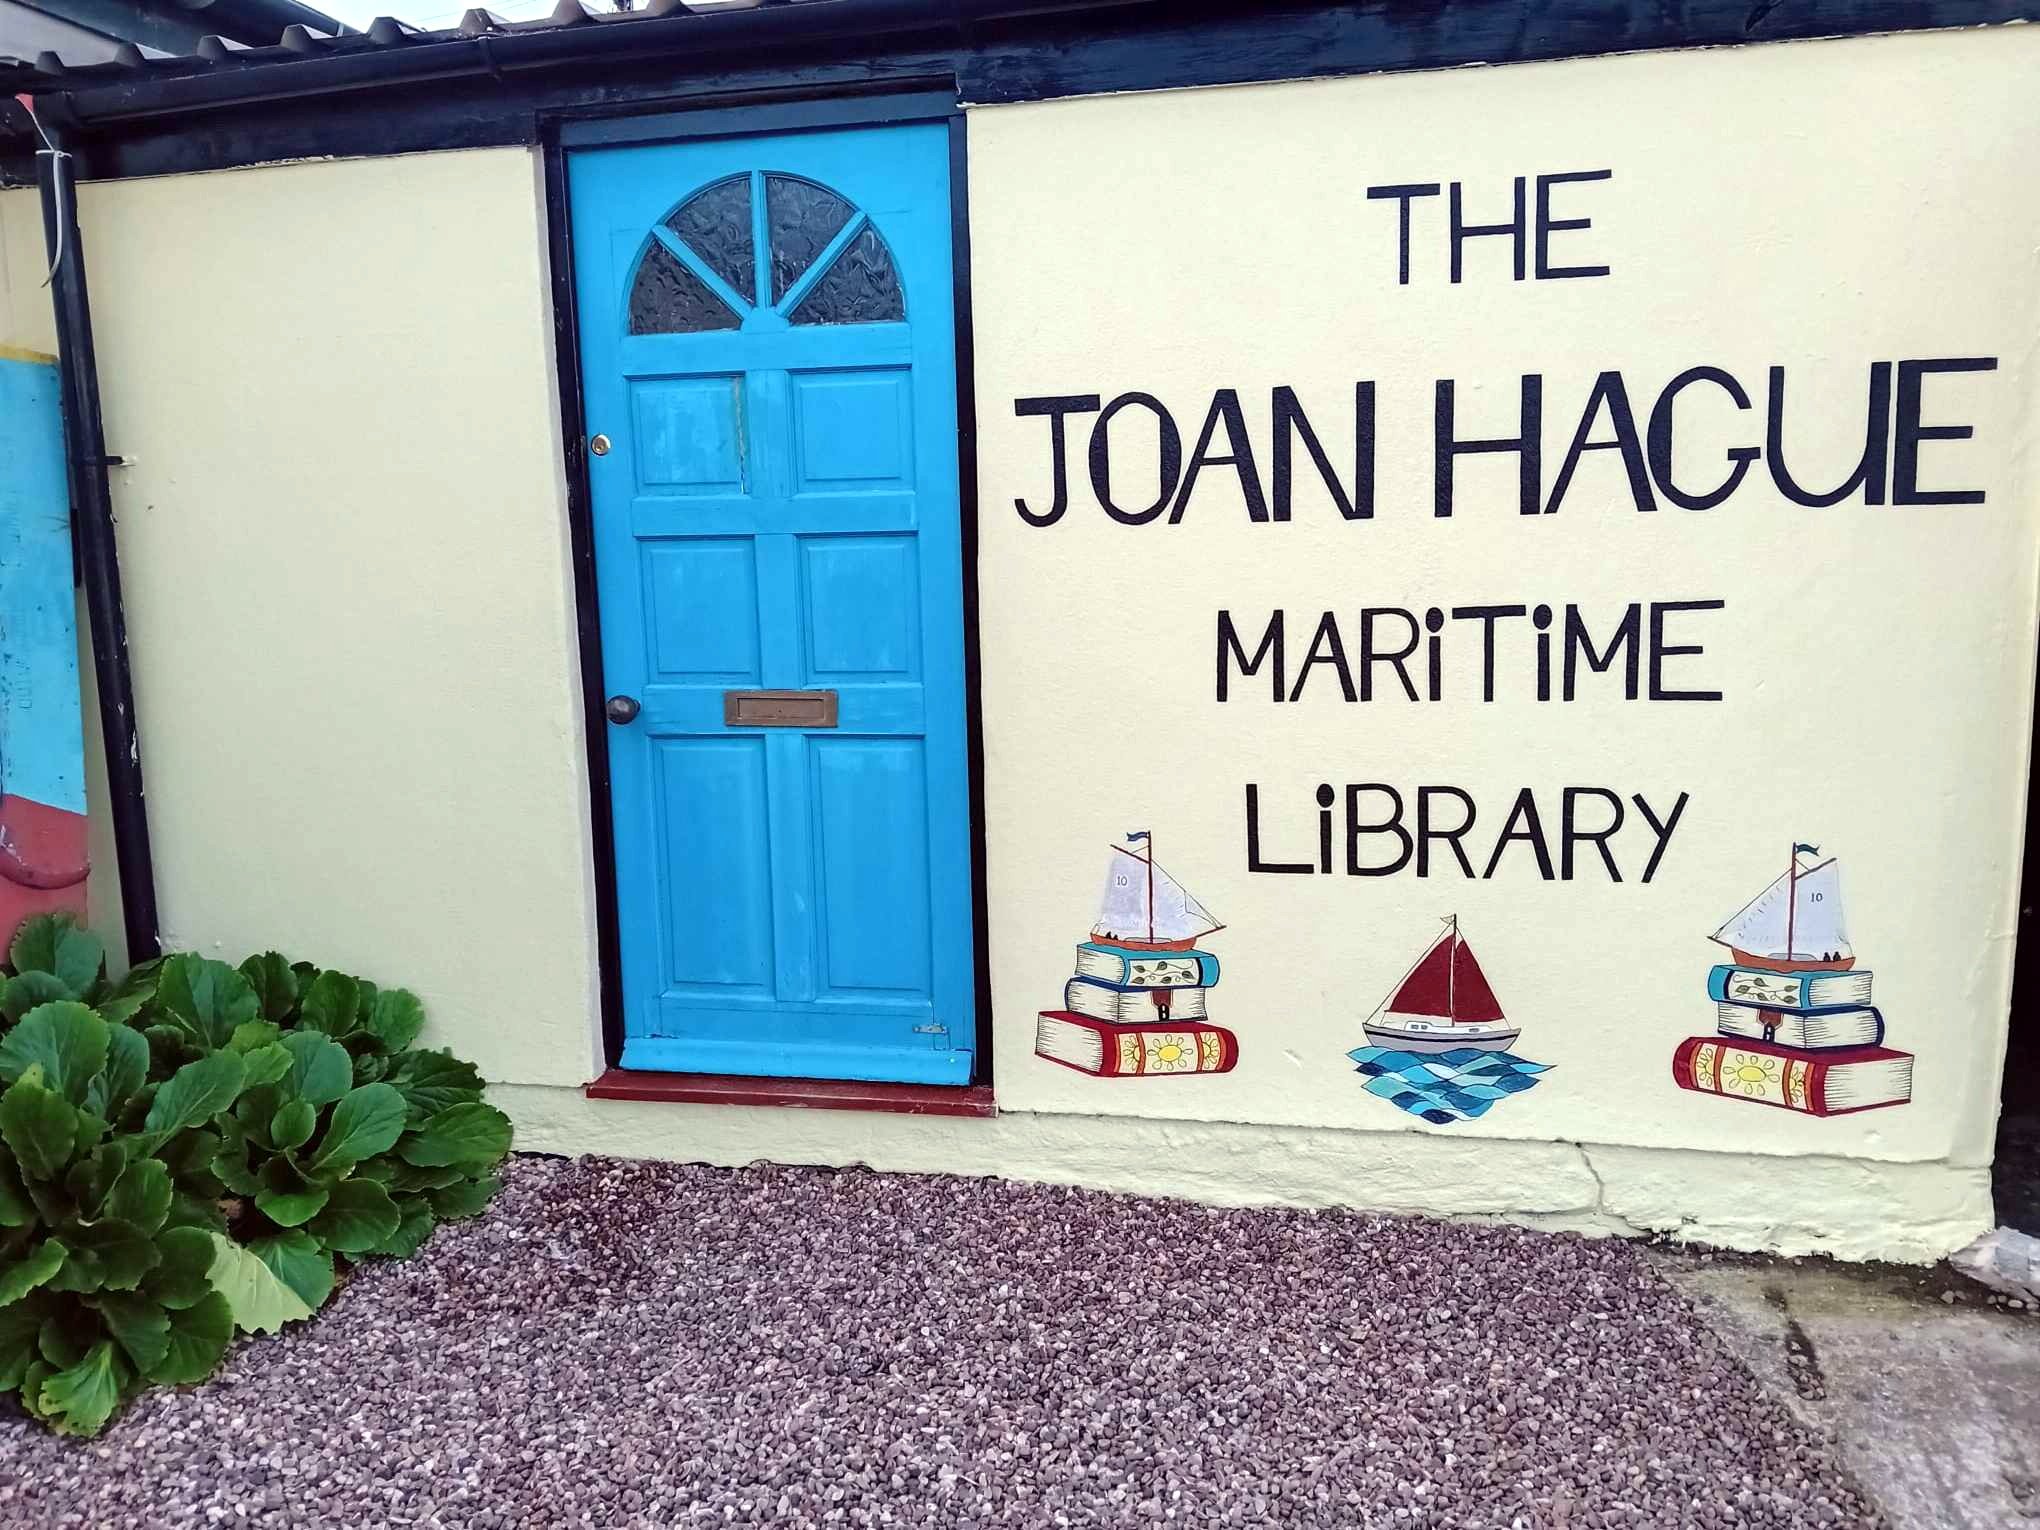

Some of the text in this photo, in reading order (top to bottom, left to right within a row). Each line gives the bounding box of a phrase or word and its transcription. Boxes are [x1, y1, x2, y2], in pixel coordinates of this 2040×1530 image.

[1367, 170, 1612, 285] THE
[1014, 358, 1998, 527] JOAN HAGUE
[1116, 875, 1129, 887] 10
[1811, 892, 1824, 903] 10
